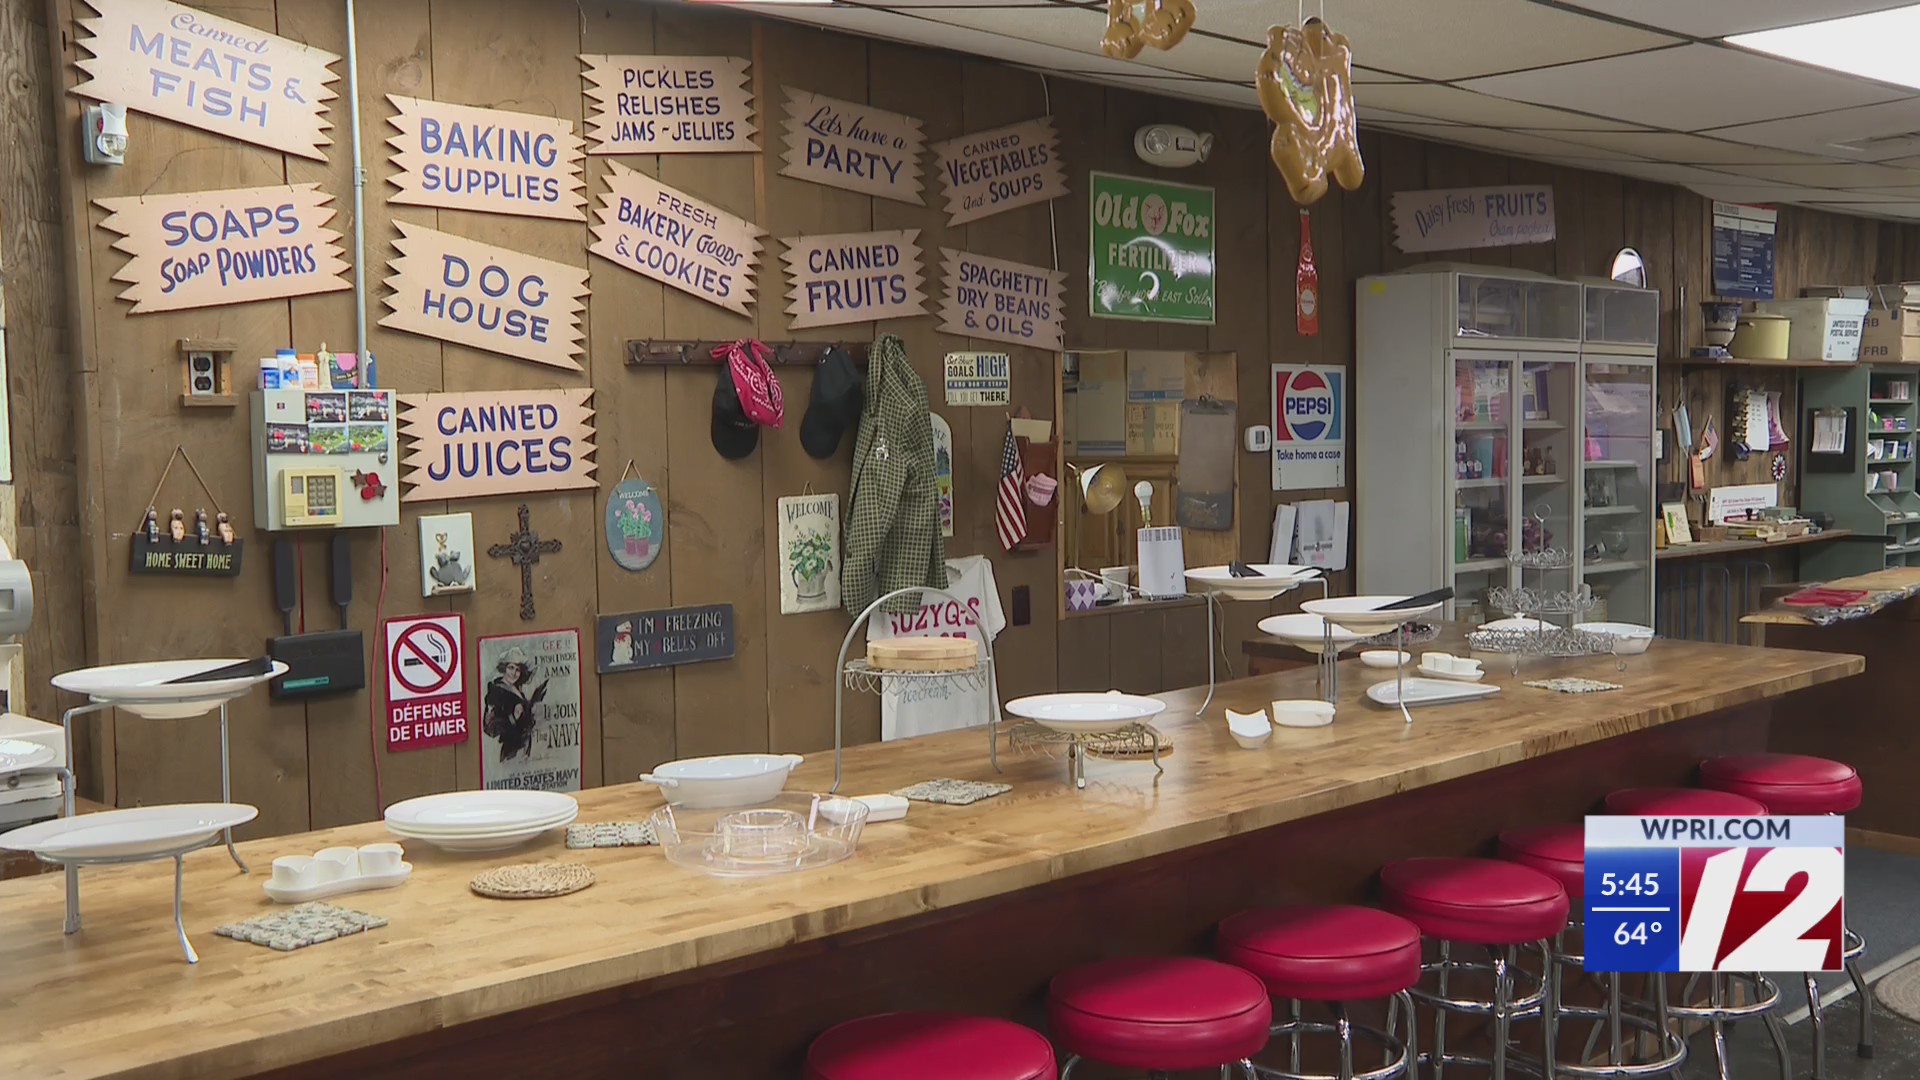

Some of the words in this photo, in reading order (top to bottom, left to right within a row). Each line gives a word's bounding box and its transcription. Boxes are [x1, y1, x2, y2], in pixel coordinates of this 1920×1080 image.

[170, 12, 269, 54] Canned
[129, 23, 272, 92] MEATS
[283, 77, 307, 104] &
[623, 68, 715, 89] PICKLES
[149, 67, 267, 128] FISH
[617, 92, 721, 116] RELISHES
[420, 117, 558, 168] BAKING
[611, 120, 655, 142] JAMS
[671, 121, 735, 142] JELLIES
[847, 116, 888, 145] have
[893, 136, 907, 150] a
[963, 134, 1021, 158] CANNED
[806, 138, 904, 184] PARTY
[946, 143, 1049, 187] VEGETABLES
[421, 163, 560, 203] SUPPLIES
[989, 173, 1043, 204] SOUPS
[161, 203, 300, 247] SOAPS
[618, 196, 694, 251] BAKERY
[656, 190, 718, 231] FRESH
[1095, 191, 1139, 229] Old
[1167, 201, 1210, 238] Fox
[1415, 203, 1444, 239] Daisy
[1446, 195, 1475, 222] Fresh
[1485, 192, 1547, 218] FRUITS
[160, 253, 210, 294] SOAP
[216, 243, 317, 287] POWDERS
[615, 233, 631, 258] &
[634, 240, 732, 298] COOKIES
[808, 244, 899, 274] CANNED
[1108, 242, 1198, 273] FERTILIZER
[442, 253, 549, 308] DOG
[805, 274, 907, 313] FRUITS
[959, 262, 1049, 298] SPAGHETTI
[957, 286, 989, 309] DRY
[995, 293, 1051, 321] BEANS
[1162, 290, 1183, 304] EAST
[422, 289, 550, 344] HOUSE
[964, 310, 979, 329] &
[985, 314, 1034, 338] OILS
[1864, 318, 1879, 327] RB
[947, 366, 974, 377] GOALS
[976, 355, 1007, 377] HIGH
[1864, 346, 1888, 356] FRB
[980, 391, 1006, 402] THERE
[1285, 397, 1331, 415] PEPSI
[437, 403, 559, 437] CANNED
[427, 436, 572, 481] JUICES
[1277, 450, 1294, 461] Take
[1295, 449, 1317, 461] home
[1318, 451, 1325, 460] a
[1325, 450, 1341, 460] case
[786, 501, 834, 524] WELCOME
[145, 552, 171, 568] HOME
[174, 553, 204, 569] SWEET
[206, 554, 232, 570] HOME
[638, 616, 654, 635] I'M
[666, 611, 722, 632] FREEZING
[542, 639, 562, 651] GEE
[634, 639, 651, 656] MY
[663, 635, 696, 653] BELLS
[707, 631, 726, 648] OFF
[551, 665, 571, 677] MAN
[393, 700, 461, 724] DÉFENSE
[554, 703, 578, 719] JOIN
[390, 723, 411, 742] DE
[414, 719, 466, 739] FUMER
[548, 722, 580, 749] NAVY
[523, 772, 555, 787] STATES
[556, 767, 579, 781] NAVY
